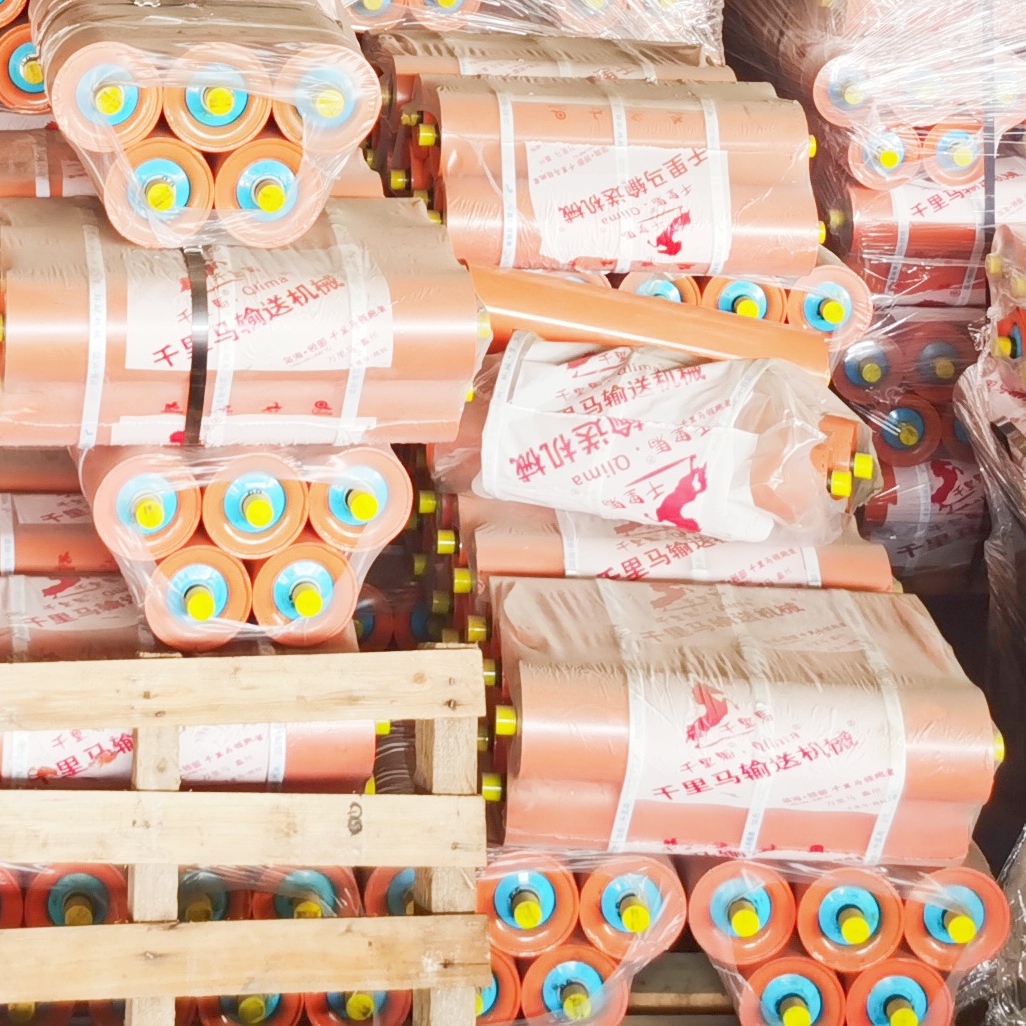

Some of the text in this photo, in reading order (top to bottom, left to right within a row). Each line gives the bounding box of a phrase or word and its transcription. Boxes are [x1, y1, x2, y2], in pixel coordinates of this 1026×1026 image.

[558, 147, 710, 224] 千里马输送机械
[600, 205, 642, 225] Qlima
[241, 275, 290, 297] Qlima
[570, 453, 631, 487] Qlima
[651, 729, 859, 801] 千里马输送机械
